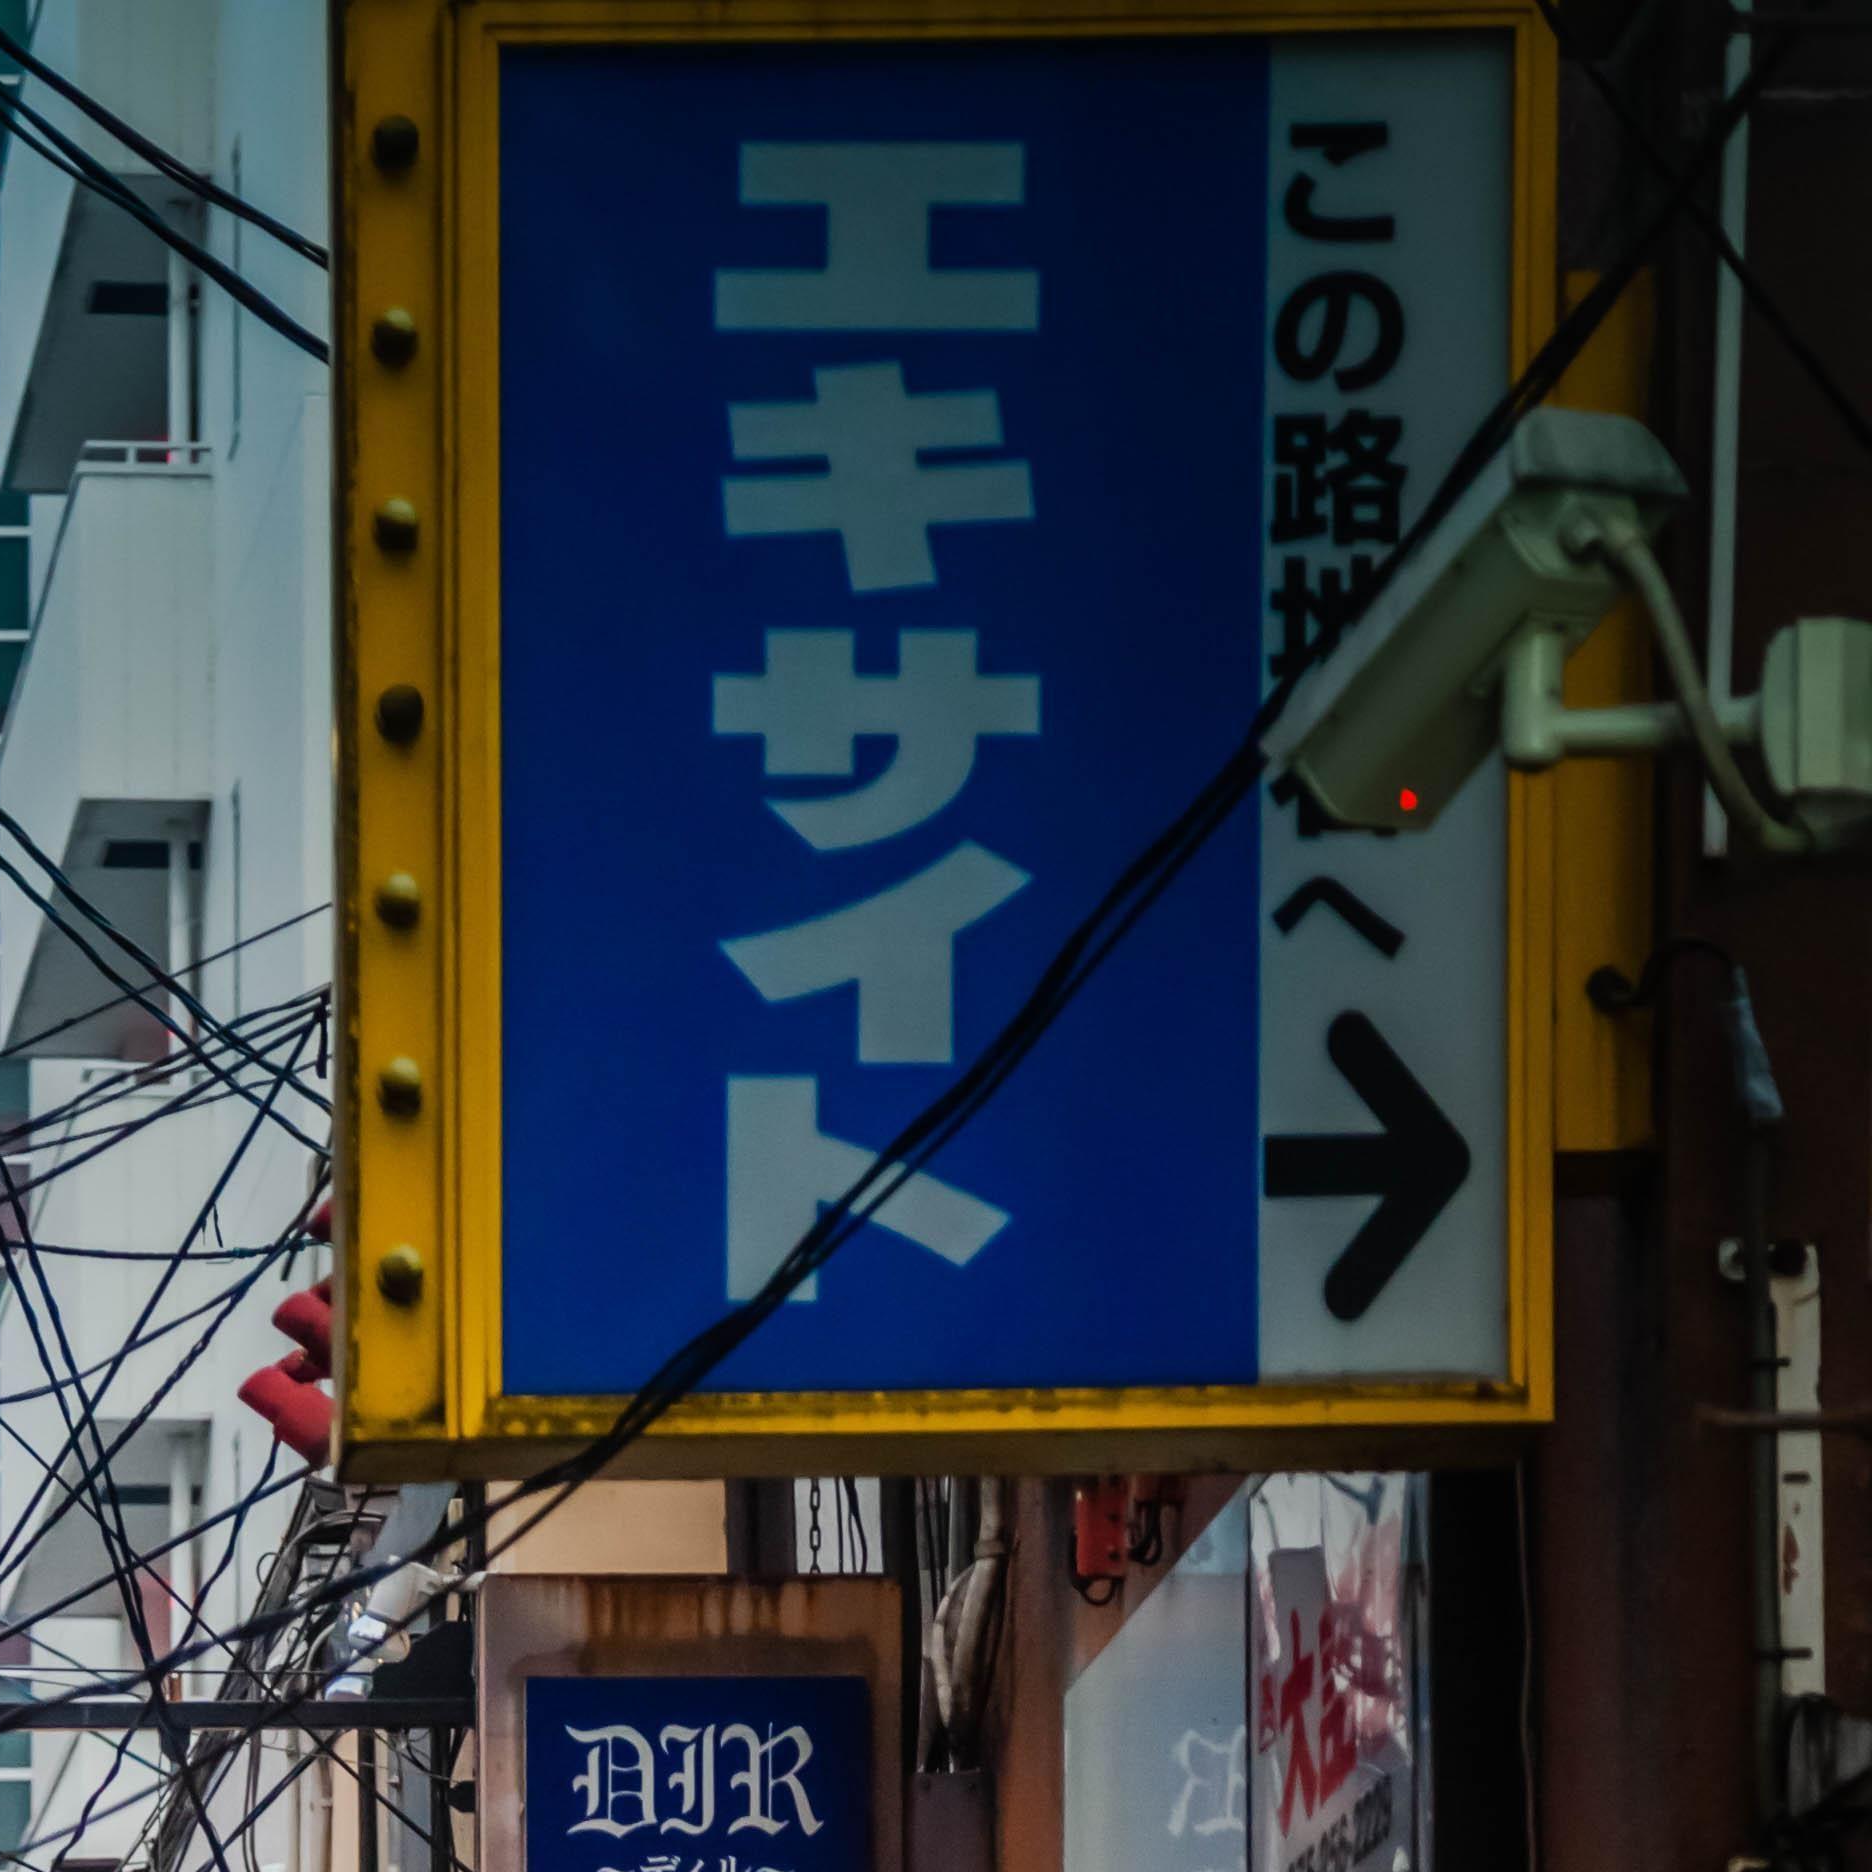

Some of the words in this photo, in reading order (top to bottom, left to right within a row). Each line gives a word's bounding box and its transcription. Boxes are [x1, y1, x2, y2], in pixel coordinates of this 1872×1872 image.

[713, 140, 1041, 1302] エキサイト
